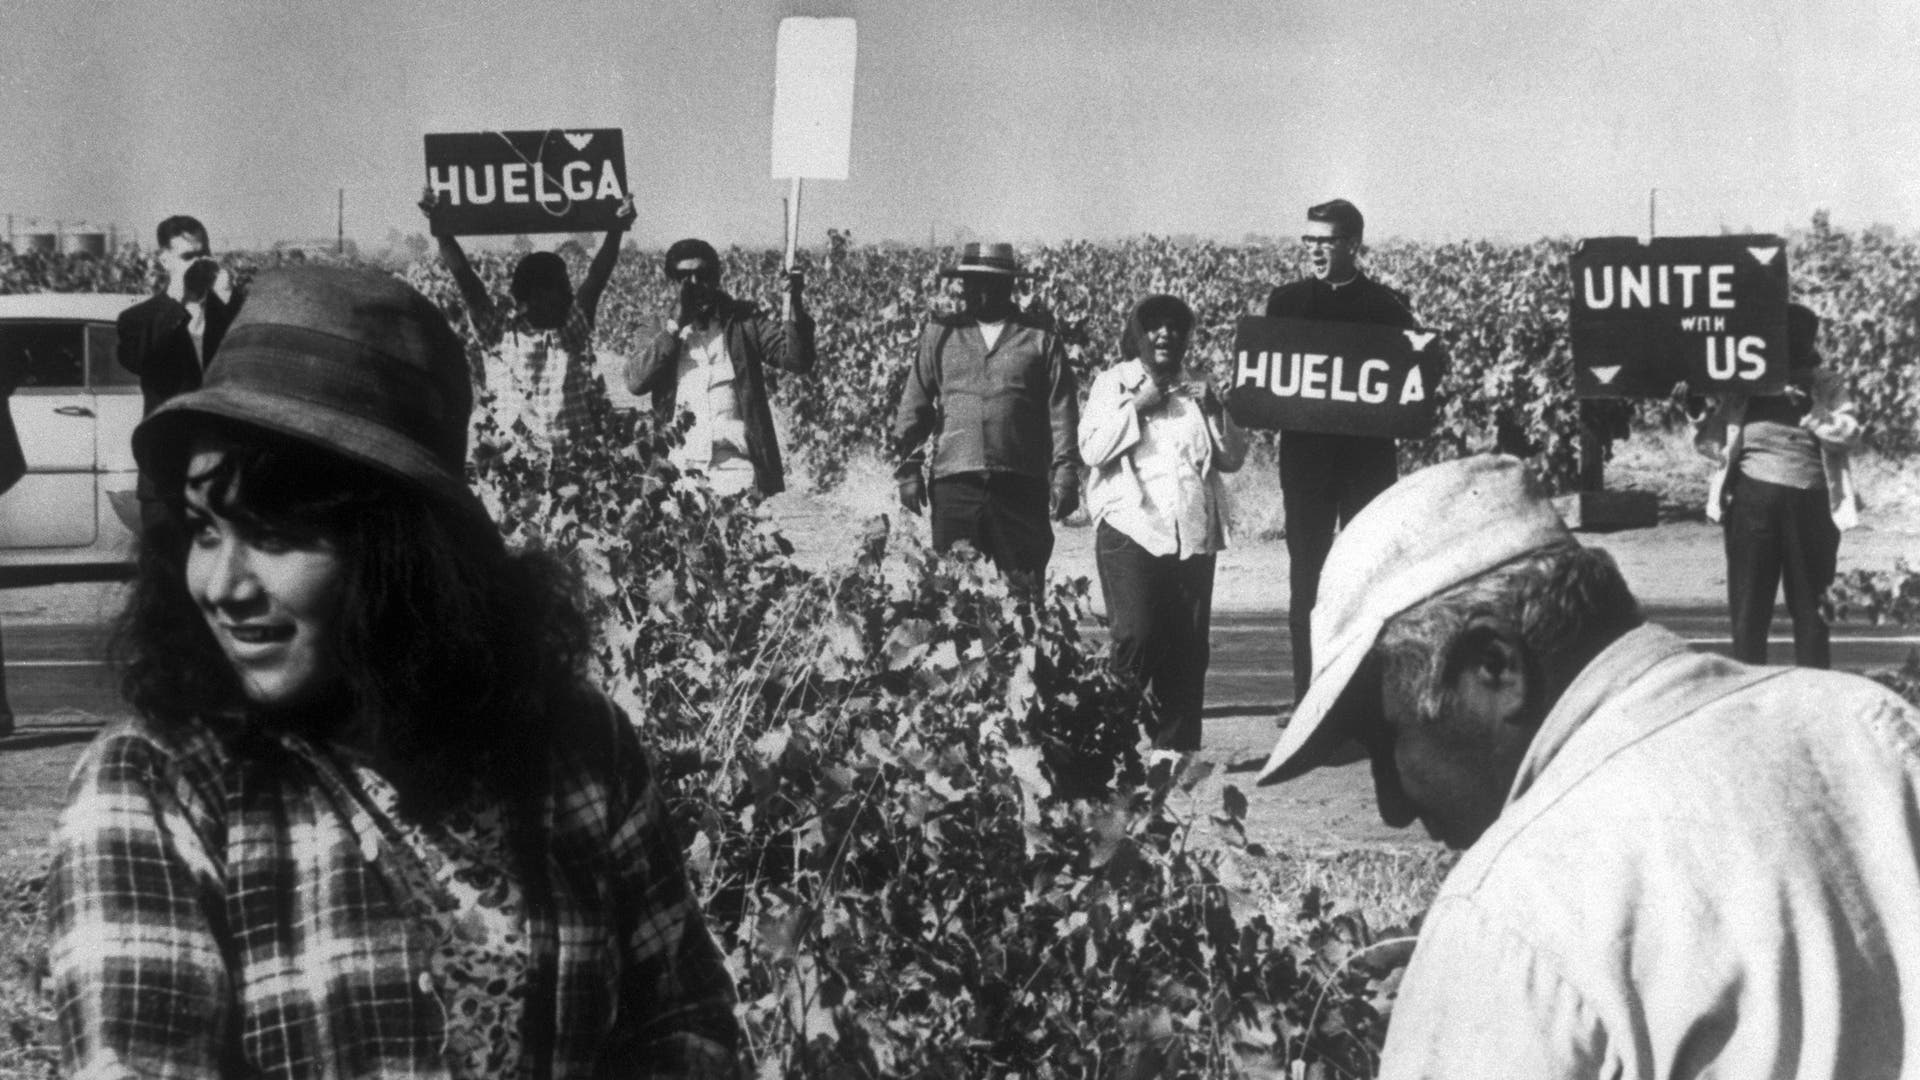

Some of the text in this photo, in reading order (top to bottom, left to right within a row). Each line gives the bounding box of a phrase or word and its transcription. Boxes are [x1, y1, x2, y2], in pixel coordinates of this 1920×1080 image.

[429, 159, 624, 206] HUELGA
[1584, 264, 1736, 309] UNITE
[1681, 316, 1725, 332] WITH
[1235, 350, 1425, 405] HUELGA
[1706, 336, 1766, 380] US
